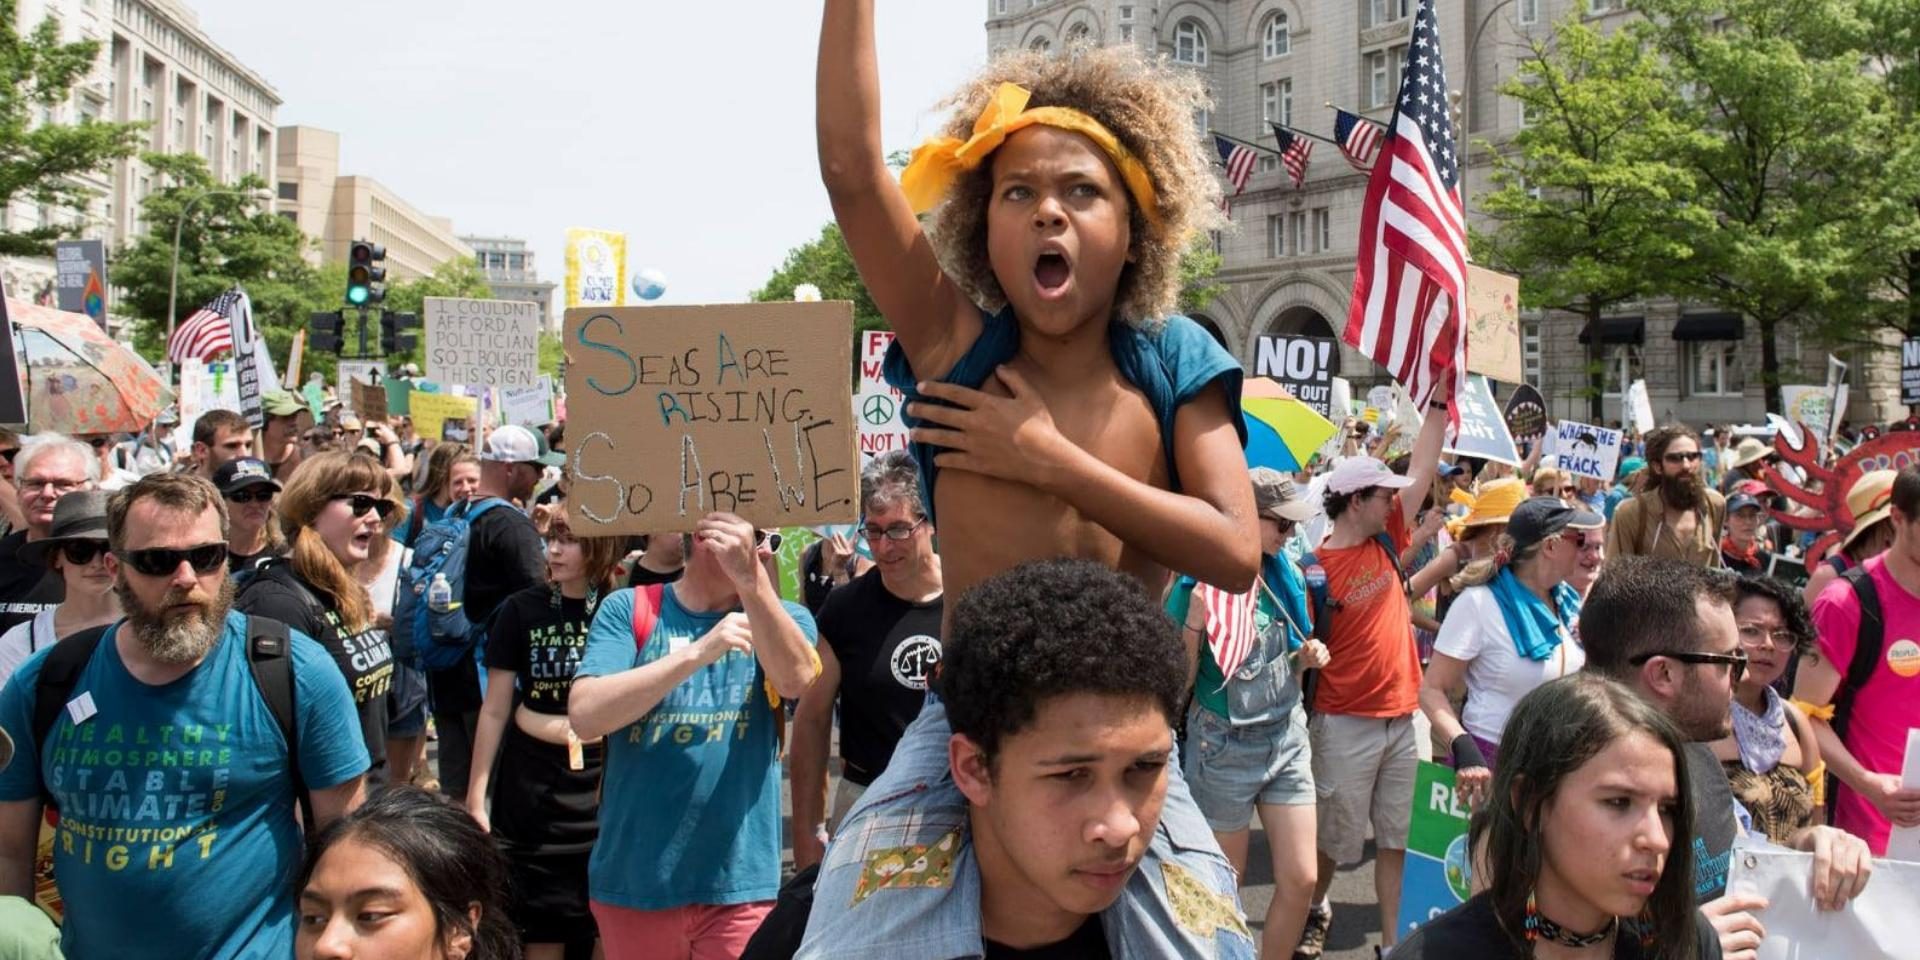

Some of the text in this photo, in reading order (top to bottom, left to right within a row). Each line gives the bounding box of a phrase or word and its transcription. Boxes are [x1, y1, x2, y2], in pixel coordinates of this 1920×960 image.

[436, 300, 448, 314] I
[436, 315, 520, 333] AFFORD A
[435, 331, 534, 349] POLITICIAN
[432, 348, 536, 367] SO I BOUGHT
[1257, 336, 1330, 381] NO!
[438, 366, 531, 386] THIS SIGN
[1300, 384, 1329, 402] OUT
[1558, 422, 1591, 441] WHAT
[861, 434, 894, 450] NOT
[1558, 455, 1602, 477] FRACK
[60, 722, 232, 744] HEALTHY
[629, 721, 749, 744] RIGHT
[53, 749, 232, 767] ATMOSPHERE
[53, 765, 231, 792] STABLE
[61, 830, 218, 870] RIGHT
